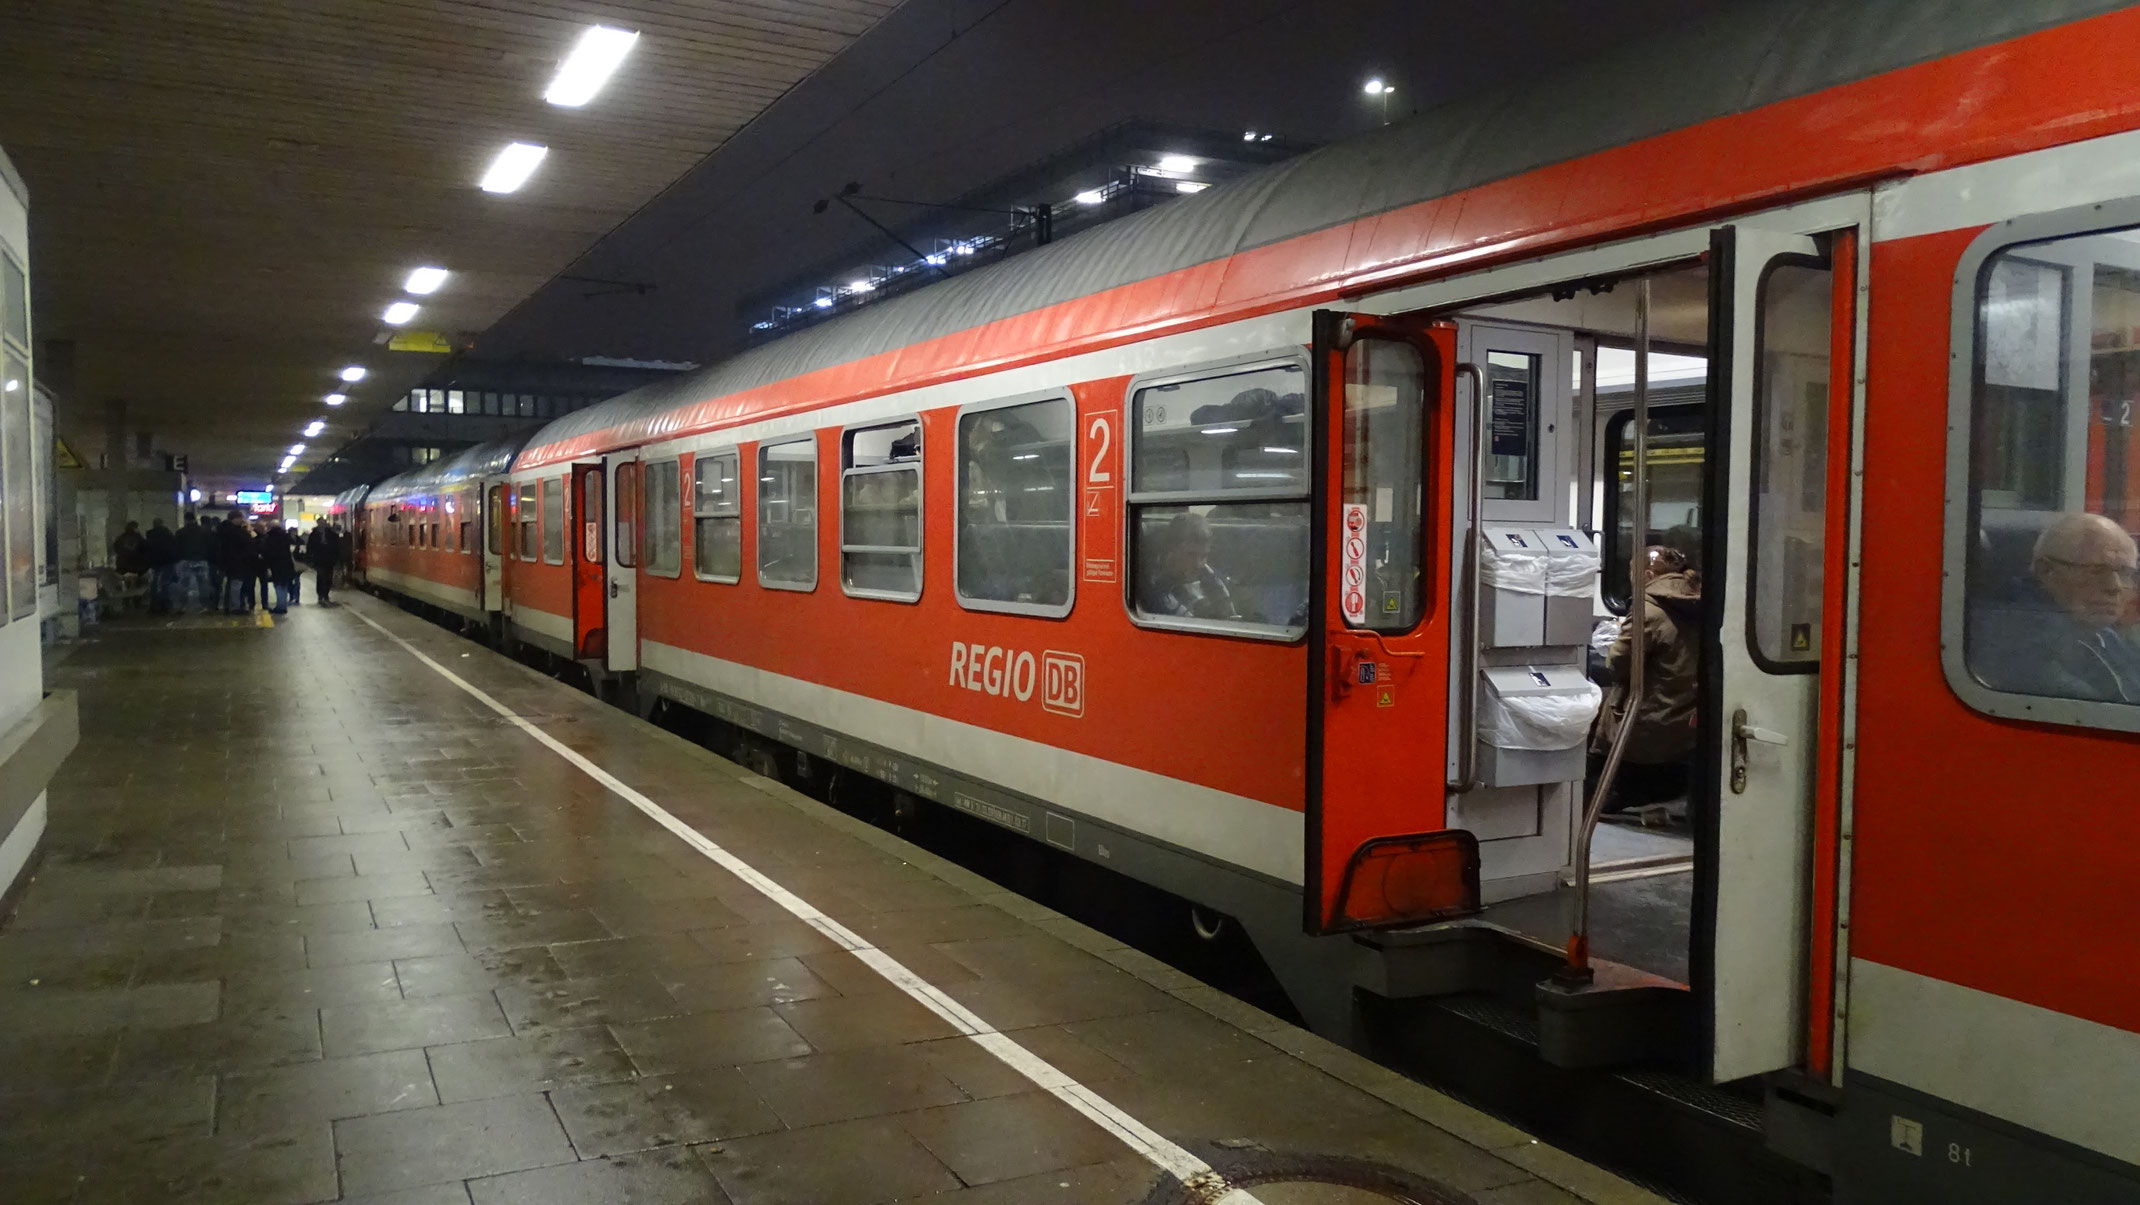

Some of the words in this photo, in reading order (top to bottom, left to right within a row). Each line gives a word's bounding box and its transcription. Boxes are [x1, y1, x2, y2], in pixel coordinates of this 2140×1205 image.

[1088, 417, 1111, 483] 2
[684, 472, 691, 507] 2
[949, 641, 1036, 702] REGIO
[1045, 657, 1082, 711] DB
